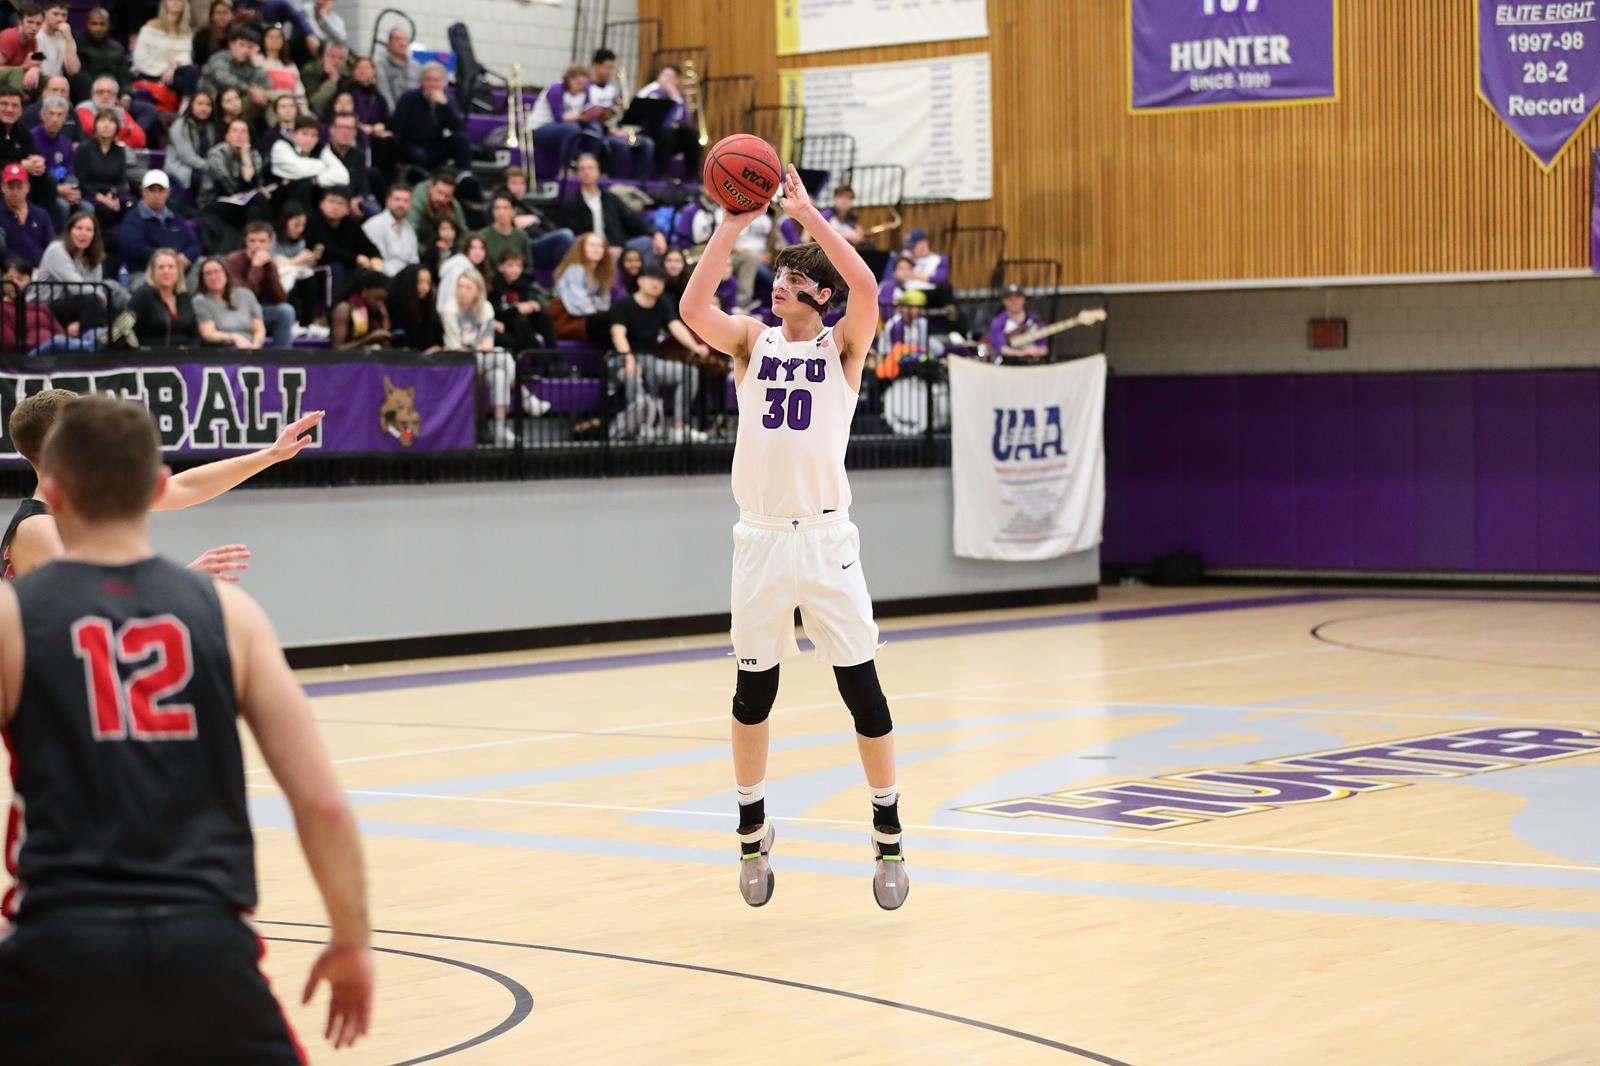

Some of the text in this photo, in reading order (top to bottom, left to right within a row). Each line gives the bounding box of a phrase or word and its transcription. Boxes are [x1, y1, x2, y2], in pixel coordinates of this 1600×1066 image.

[1496, 1, 1595, 22] ELITE EIGHT
[1170, 35, 1292, 72] HUNTER
[1508, 31, 1584, 52] 1997-98
[1190, 73, 1233, 91] SINCE
[1523, 61, 1568, 83] 28-2
[1508, 93, 1585, 116] Record
[740, 166, 773, 192] NCAA
[757, 356, 826, 382] NYU
[762, 388, 812, 430] 30
[992, 406, 1066, 461] UAA
[71, 614, 198, 741] 12
[950, 727, 1600, 831] HUNTER
